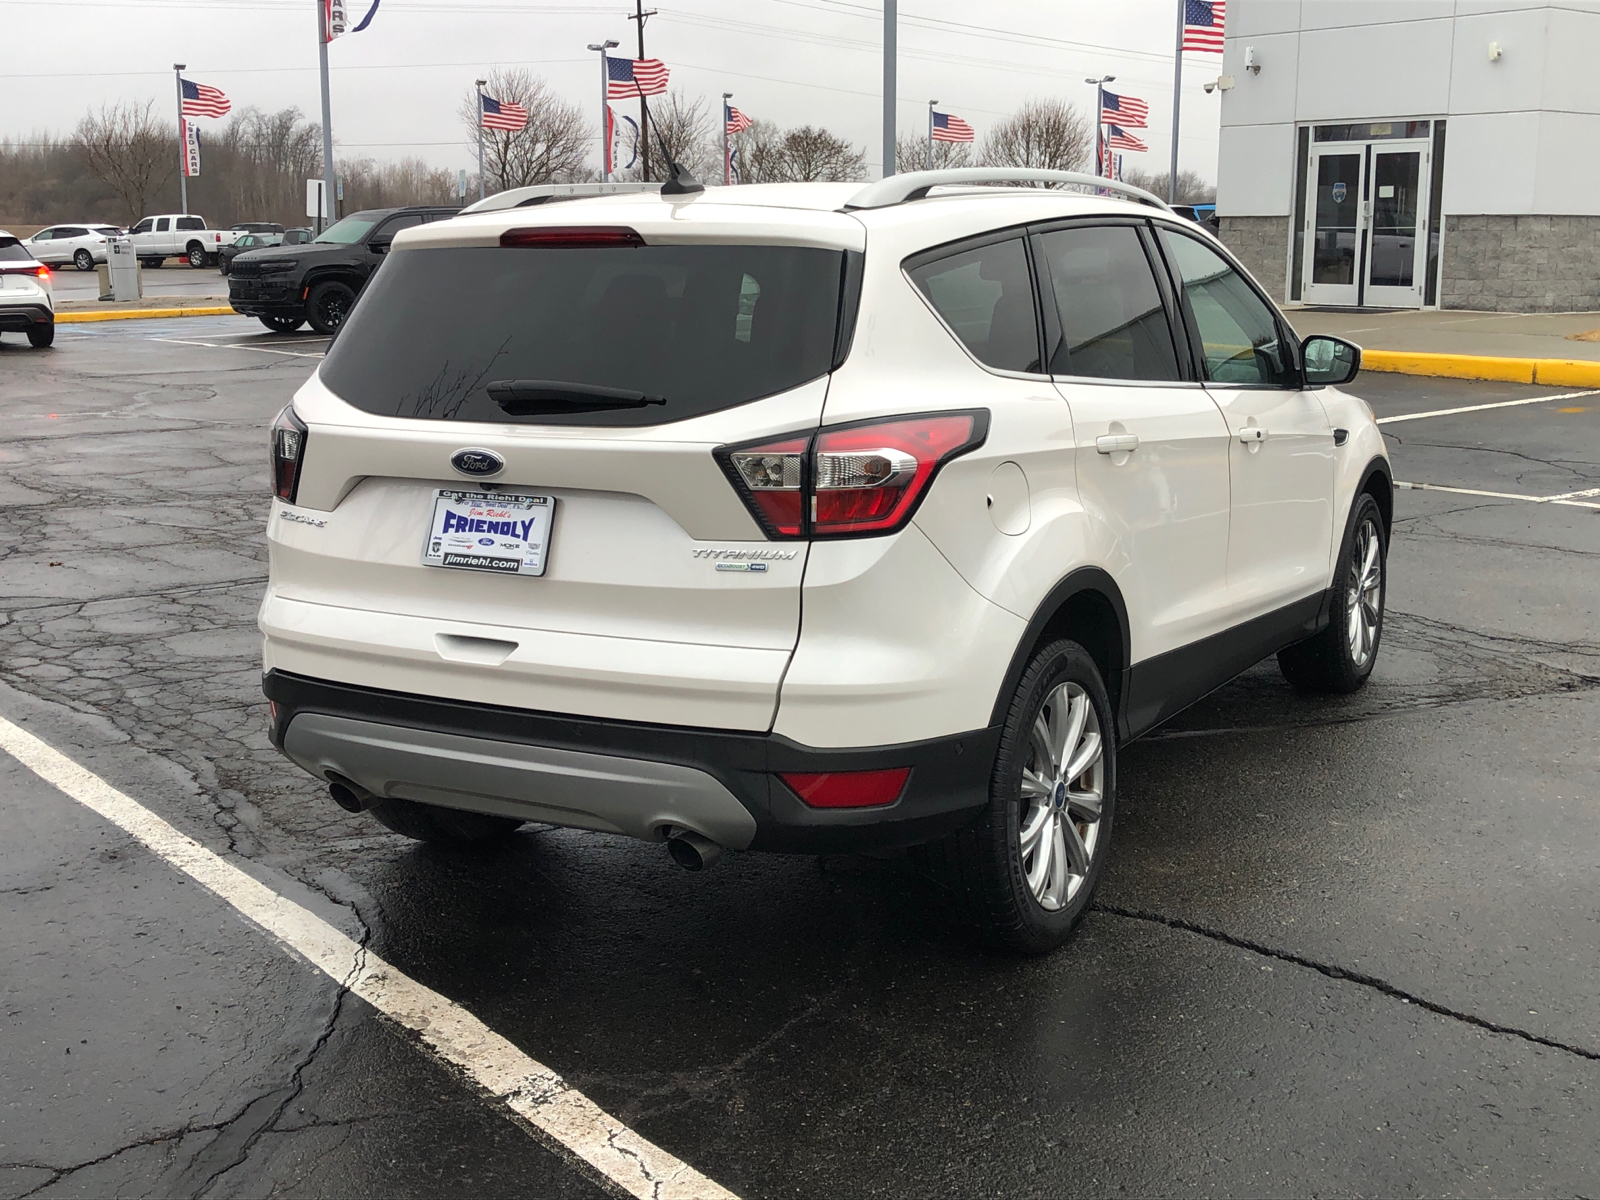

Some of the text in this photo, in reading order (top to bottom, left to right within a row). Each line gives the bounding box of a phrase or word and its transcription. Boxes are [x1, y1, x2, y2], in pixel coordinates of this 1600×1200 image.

[189, 148, 199, 174] CARS
[461, 454, 489, 471] Ford
[465, 492, 484, 500] the
[486, 493, 516, 501] Riehl
[468, 507, 512, 518] Jim Riehl's
[442, 509, 536, 542] FRIENDLY
[444, 553, 518, 569] jimriehl.com
[692, 548, 799, 560] TITANIUM
